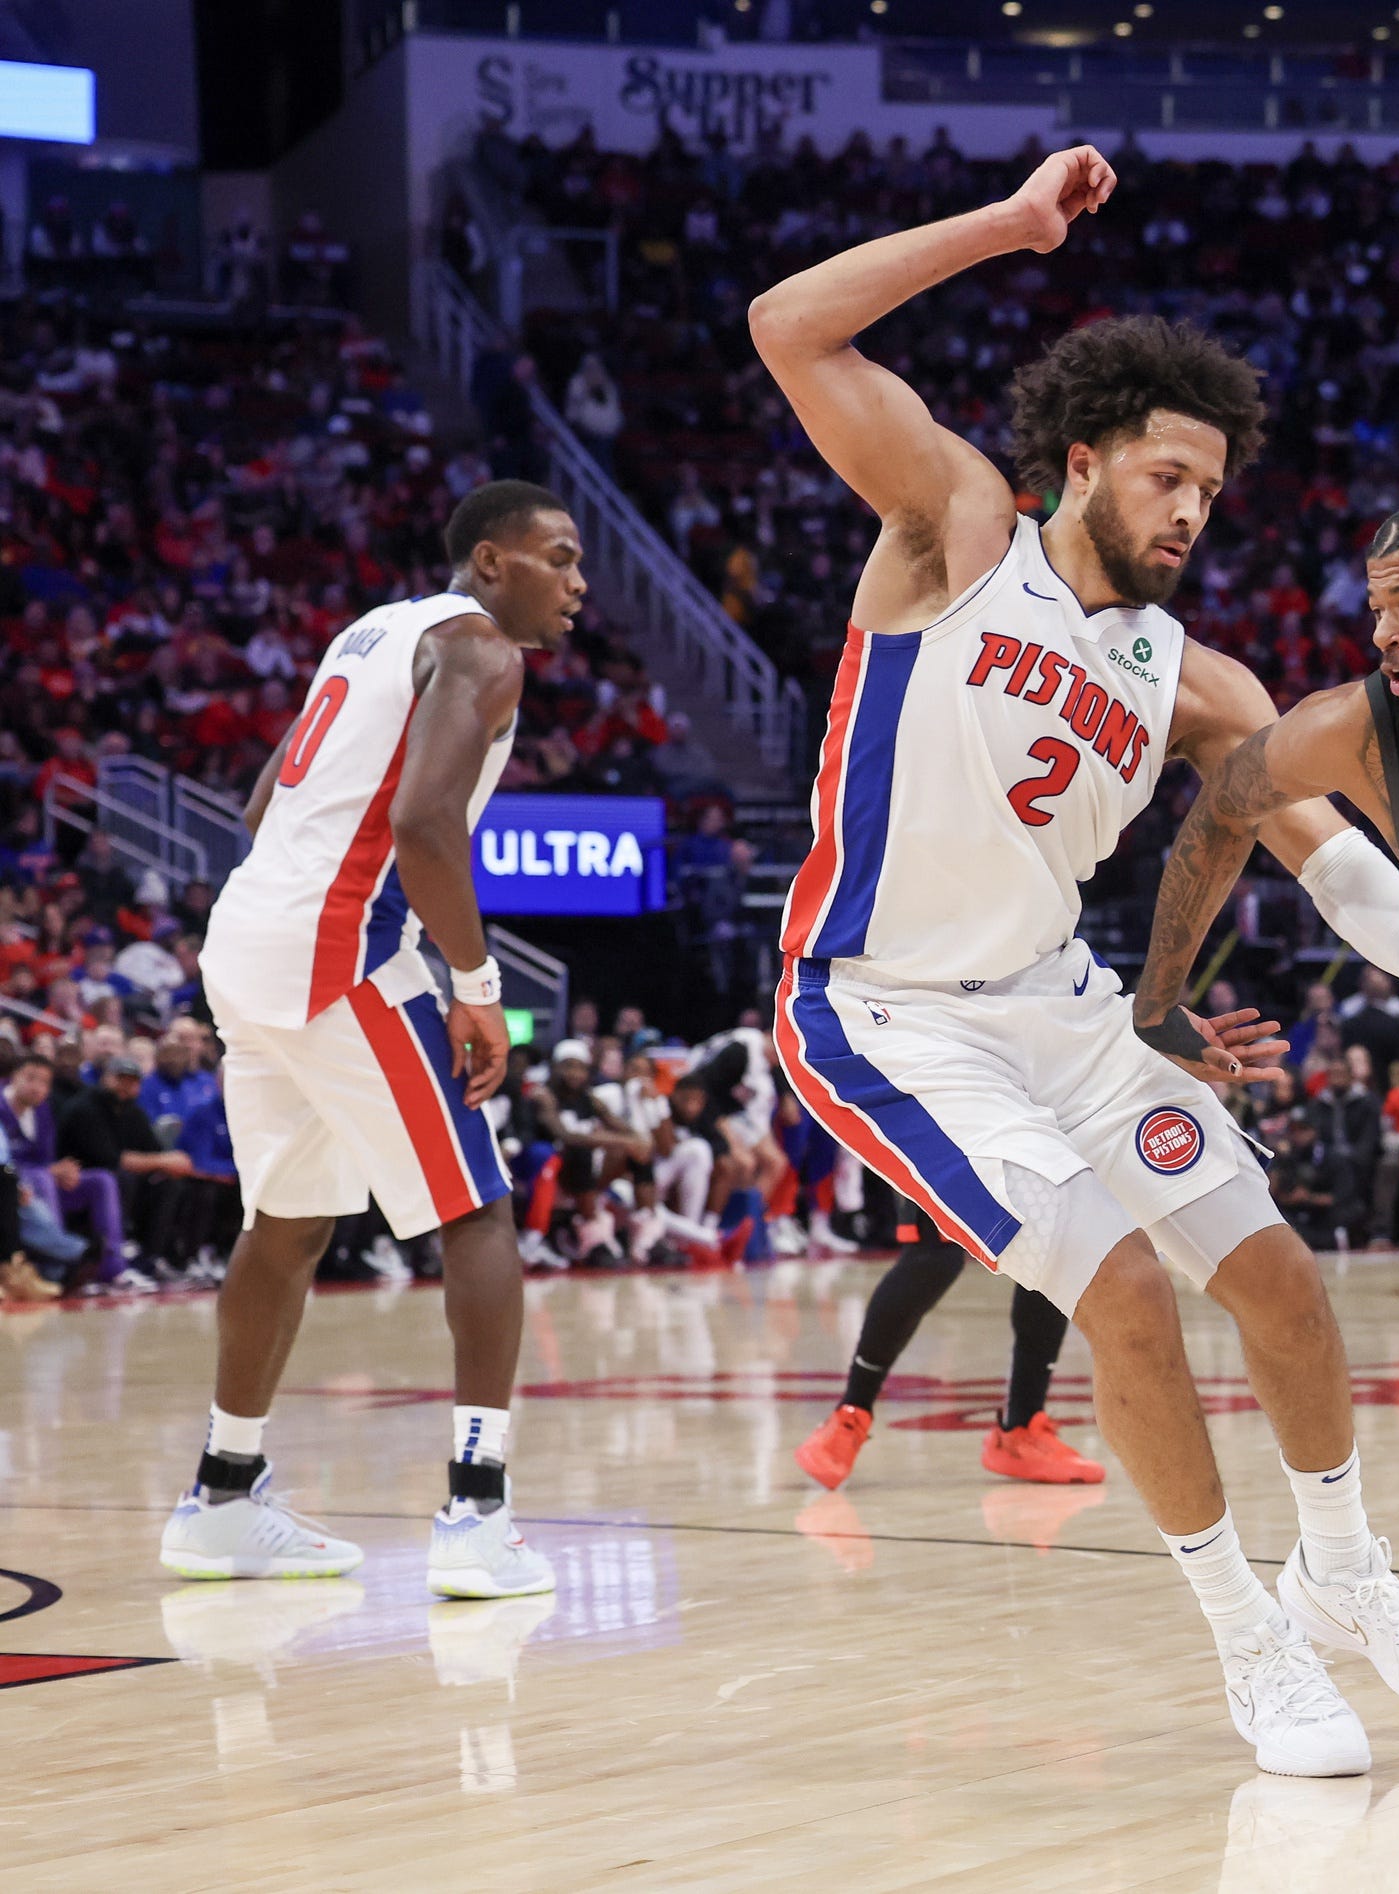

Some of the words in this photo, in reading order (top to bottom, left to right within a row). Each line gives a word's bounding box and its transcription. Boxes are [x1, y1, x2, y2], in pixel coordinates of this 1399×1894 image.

[1108, 648, 1161, 688] StockX
[278, 675, 350, 788] 0
[966, 631, 1150, 784] PISTONS
[1007, 736, 1081, 827] 2
[480, 829, 644, 877] ULTRA
[1147, 1122, 1187, 1149] DETROIT
[1152, 1132, 1193, 1160] PISTONS
